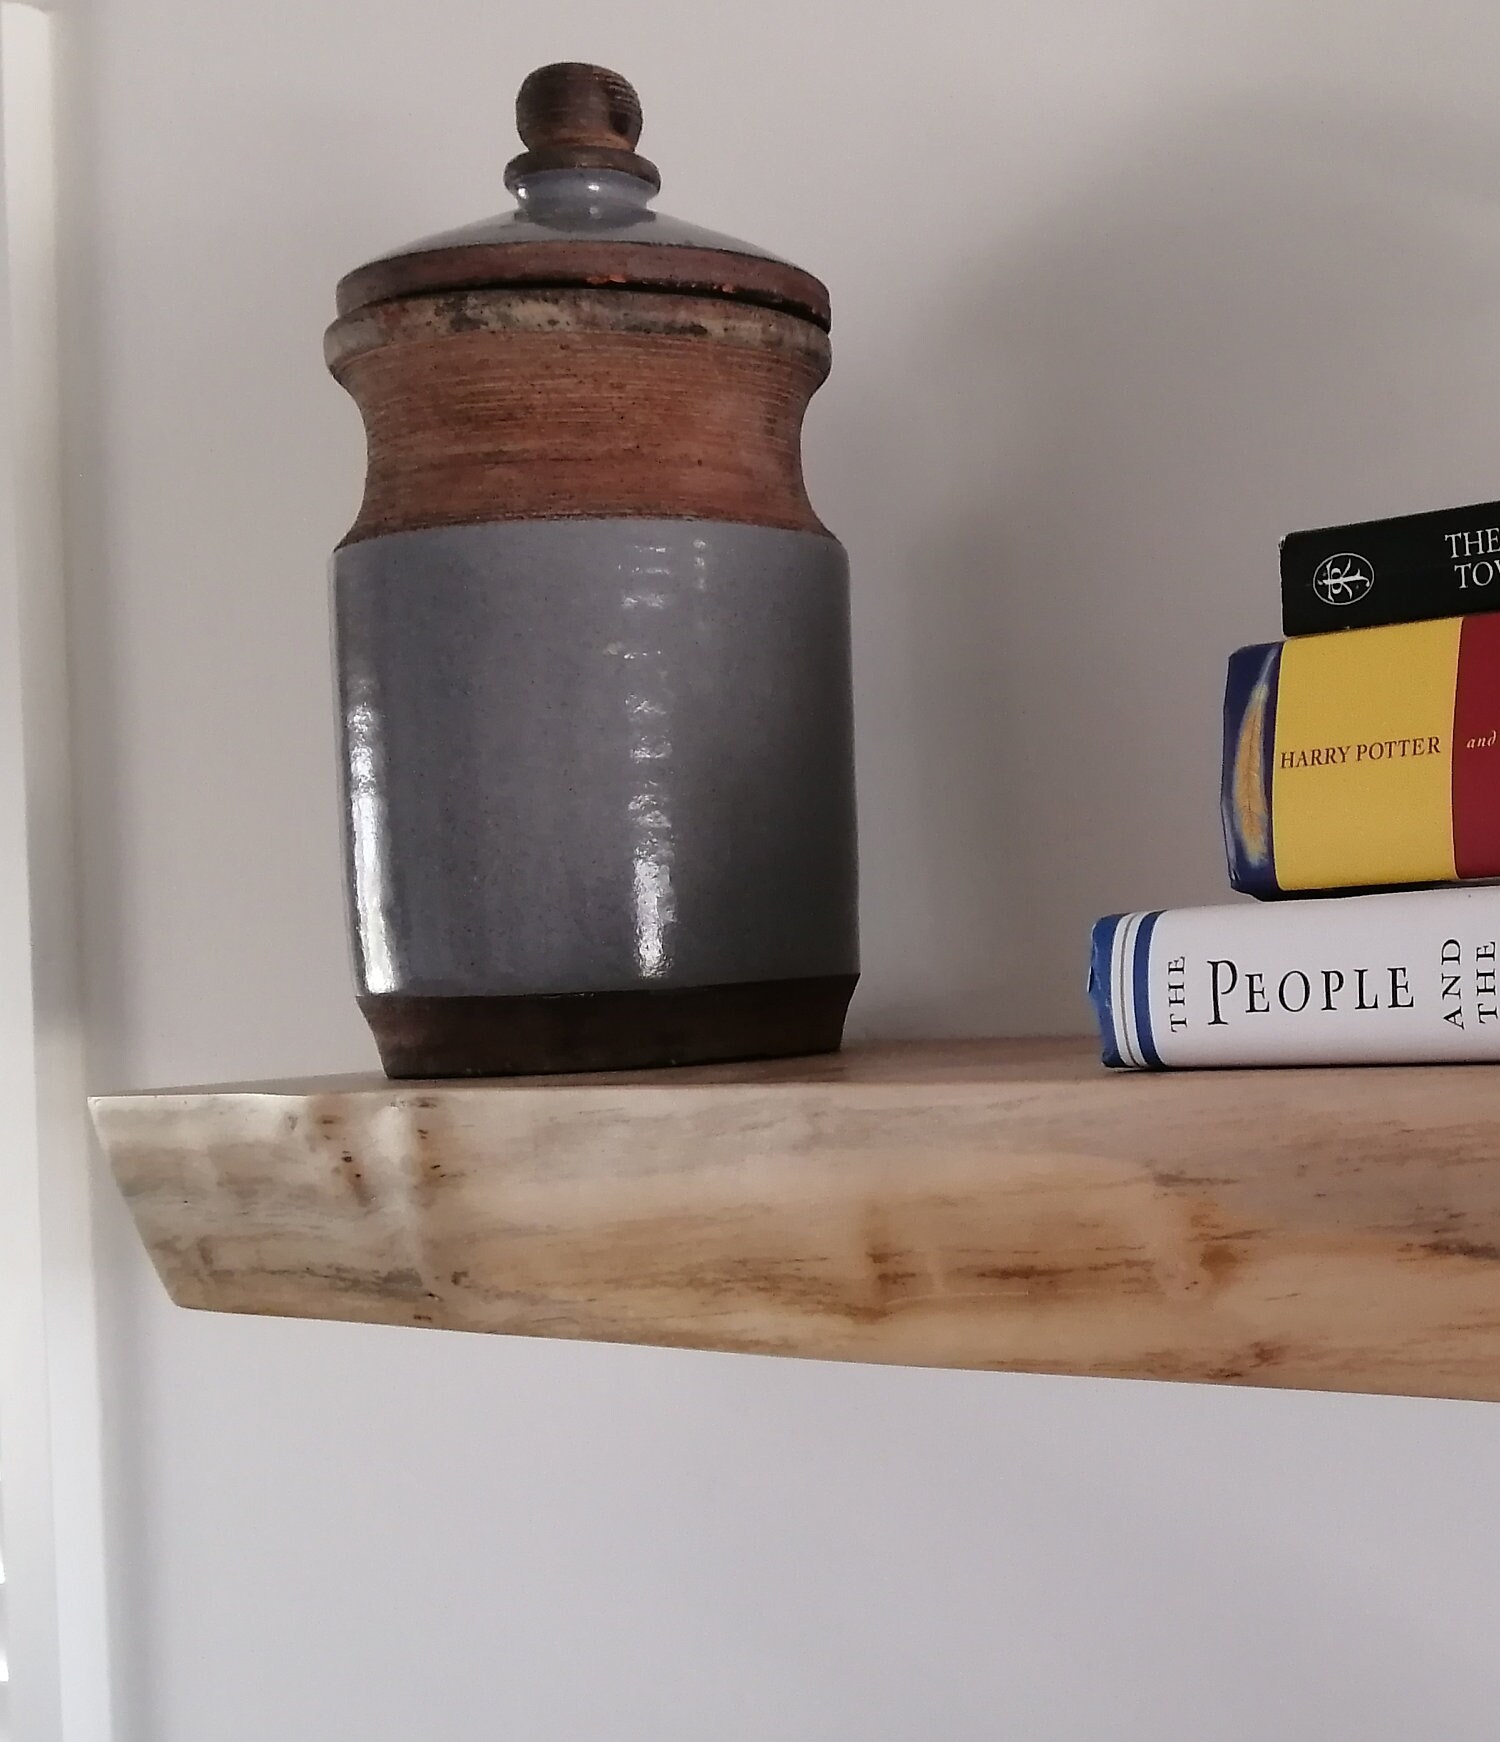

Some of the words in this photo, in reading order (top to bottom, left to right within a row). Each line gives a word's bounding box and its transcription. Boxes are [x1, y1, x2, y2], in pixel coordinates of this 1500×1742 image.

[1280, 746, 1351, 770] HARRY
[1355, 736, 1442, 762] POTTER
[1466, 730, 1498, 749] and
[1167, 955, 1188, 1033] THE
[1206, 959, 1415, 1026] PEOPLE
[1441, 938, 1465, 1030] AND
[1475, 940, 1499, 1024] THE
